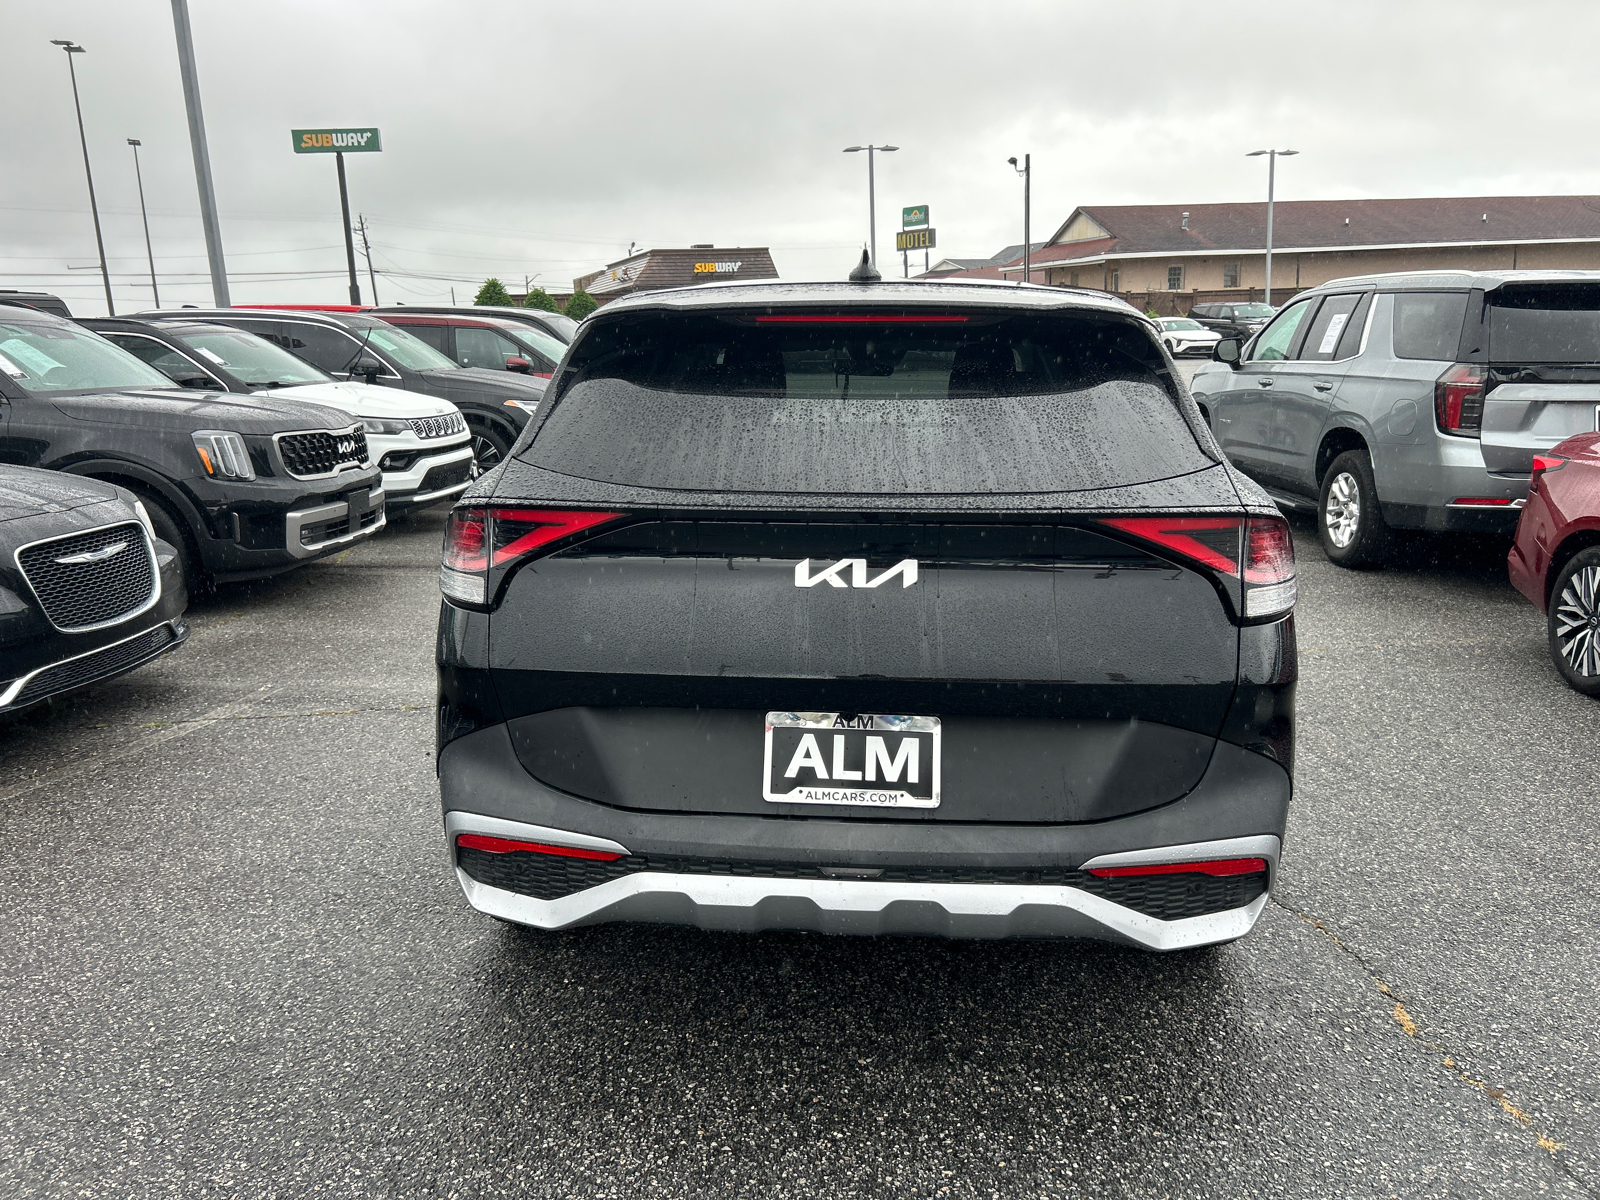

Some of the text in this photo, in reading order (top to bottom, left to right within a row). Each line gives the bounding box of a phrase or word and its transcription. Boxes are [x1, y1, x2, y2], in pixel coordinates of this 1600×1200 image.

[301, 132, 372, 148] SUBWAY
[897, 231, 932, 249] MOTEL
[693, 261, 742, 273] SUBWAY
[794, 558, 918, 588] KIA
[832, 715, 874, 729] ALM
[783, 733, 920, 783] ALM
[805, 790, 898, 804] ALMCARS.COM
